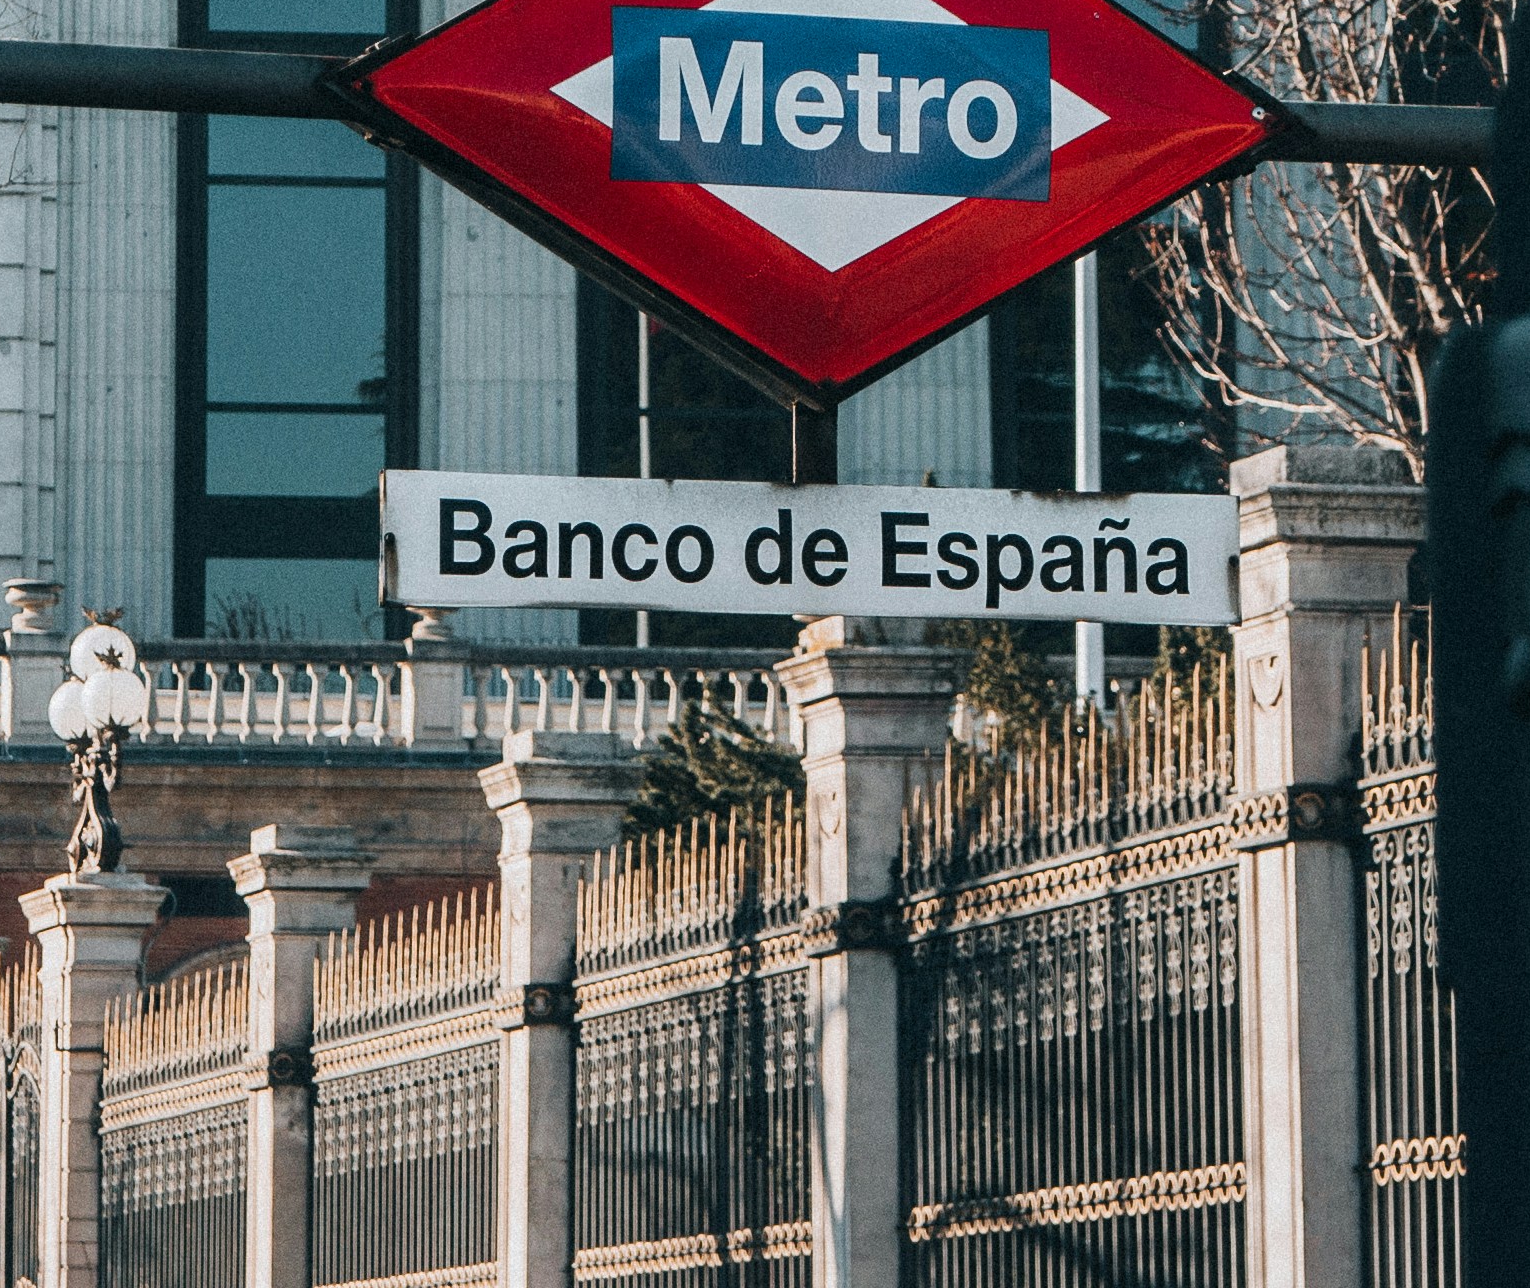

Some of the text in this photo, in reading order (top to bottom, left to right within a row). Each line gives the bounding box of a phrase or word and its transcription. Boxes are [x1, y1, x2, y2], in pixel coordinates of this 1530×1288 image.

[658, 35, 1019, 161] Metro
[437, 498, 1191, 609] Banco de España
